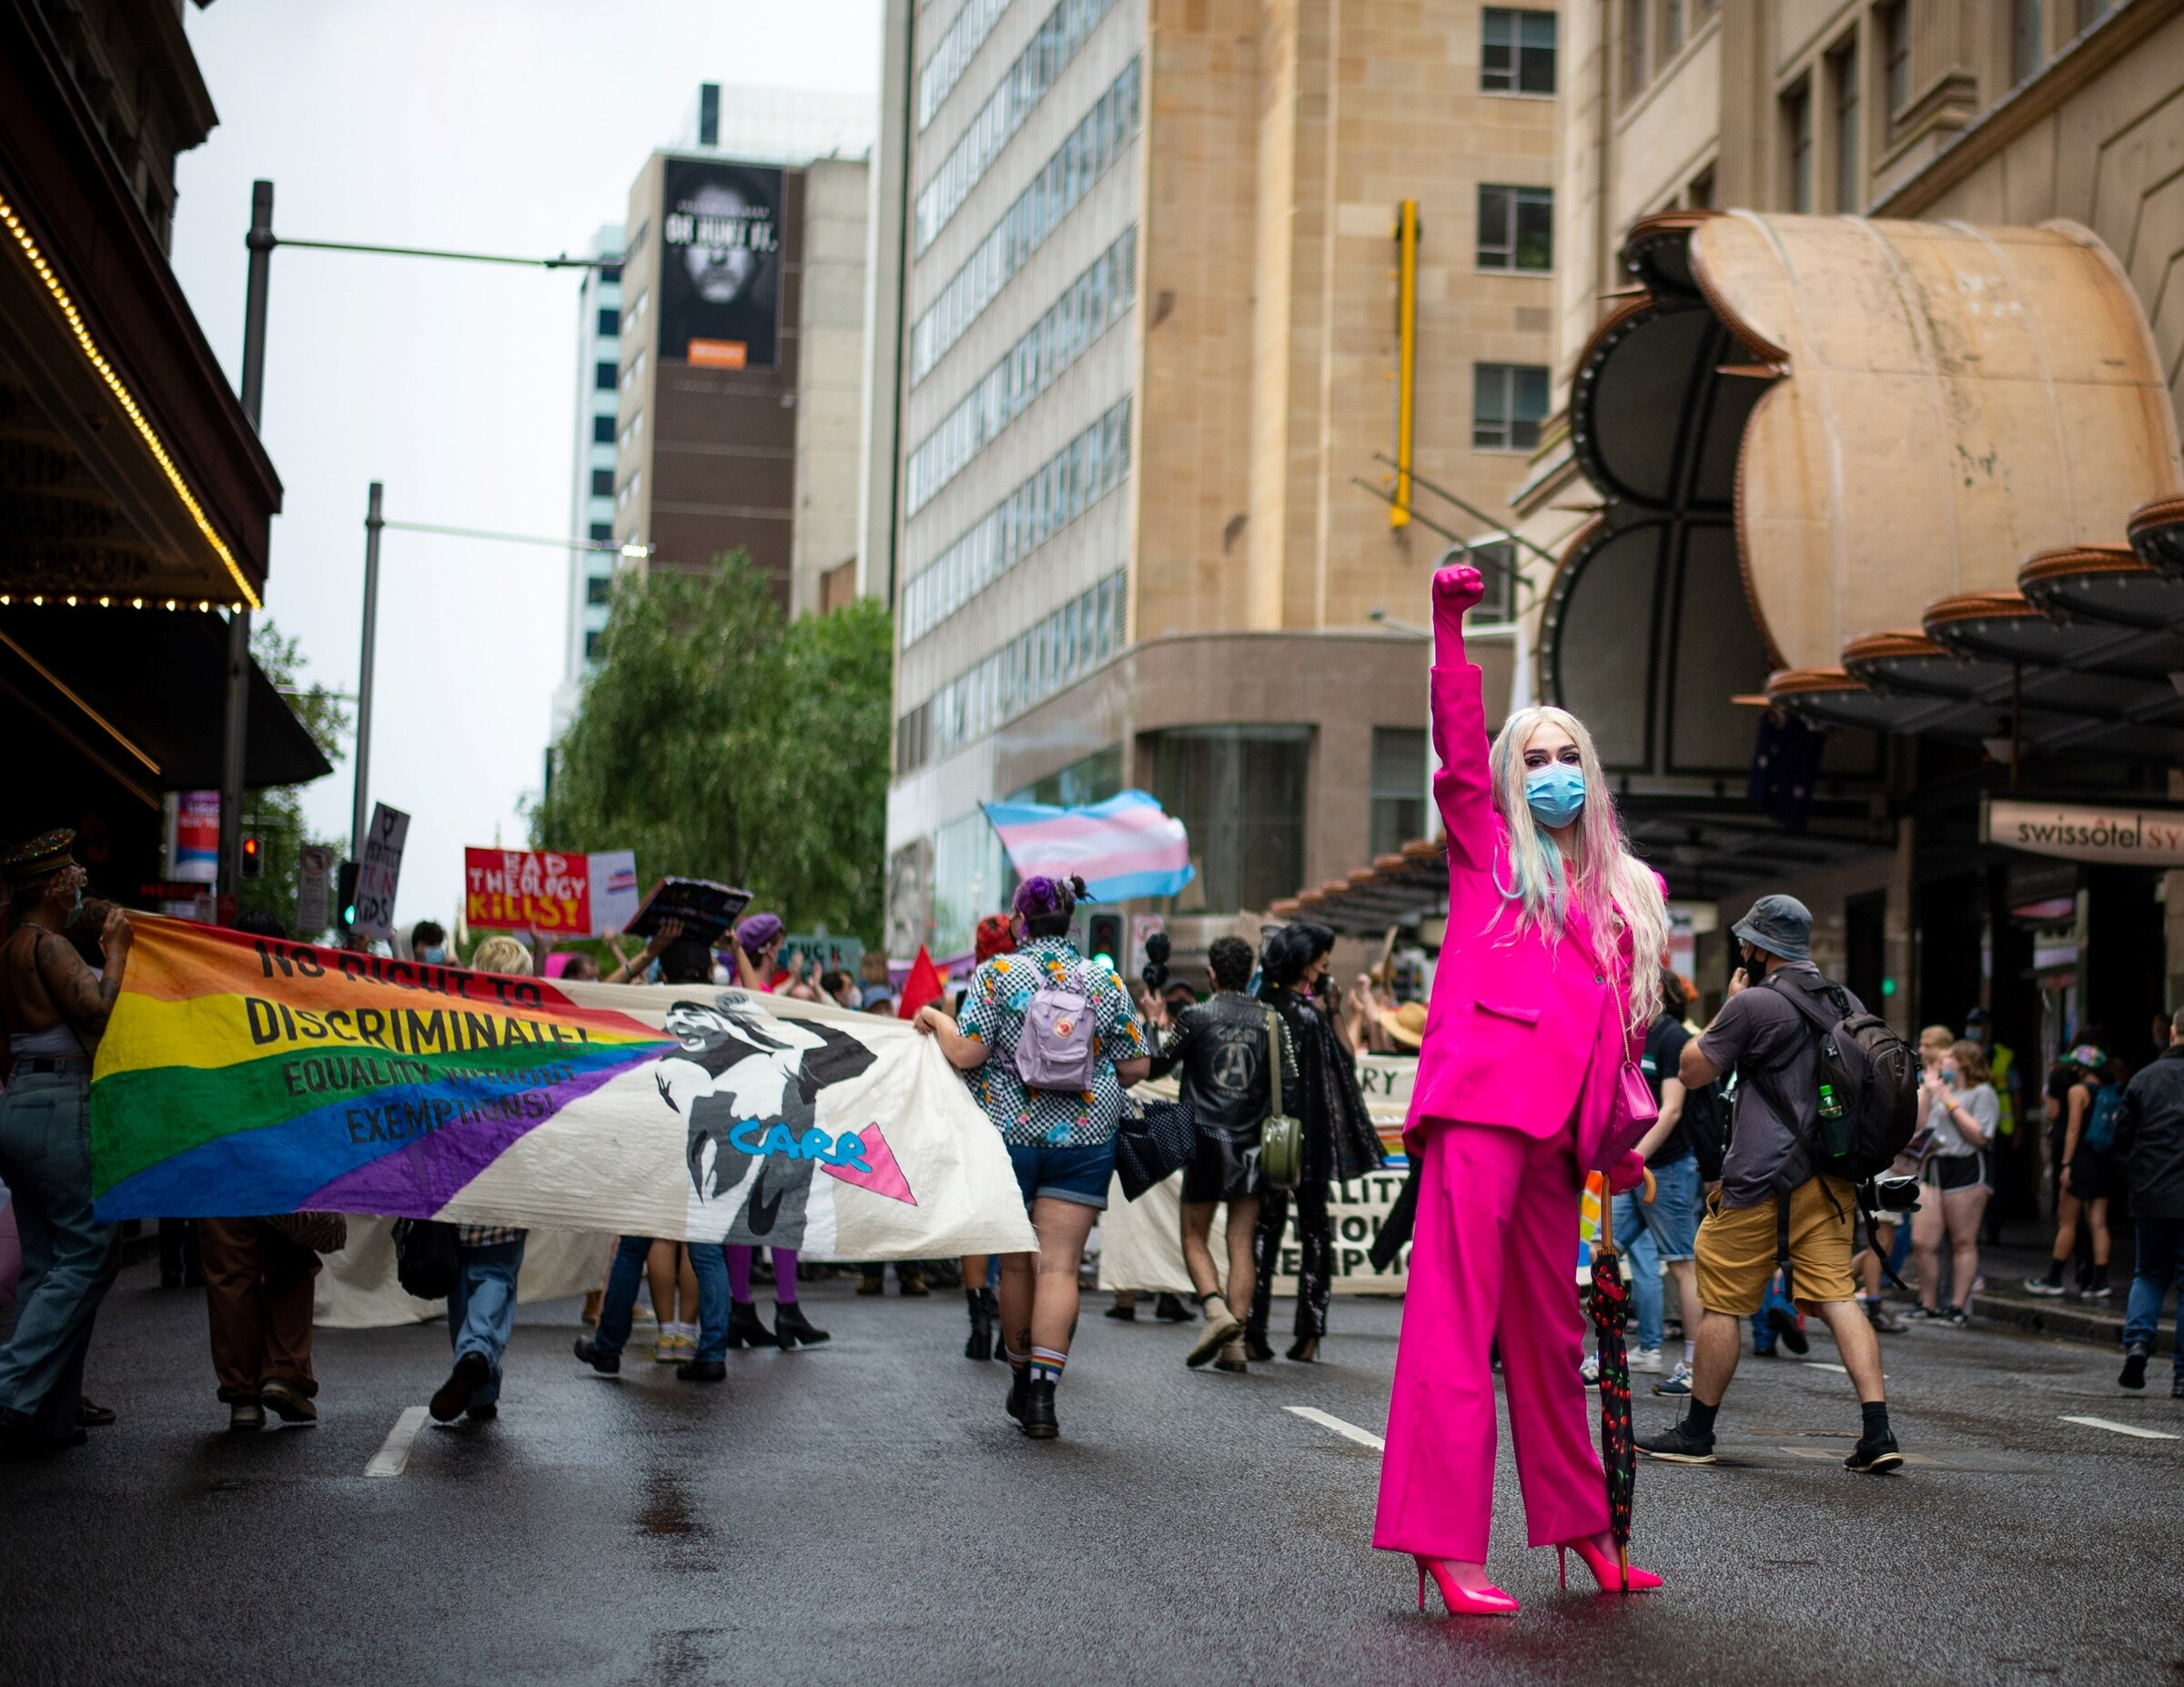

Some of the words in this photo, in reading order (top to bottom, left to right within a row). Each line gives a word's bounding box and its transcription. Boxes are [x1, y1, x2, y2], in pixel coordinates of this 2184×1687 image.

[469, 867, 586, 900] THEOLOGY
[504, 851, 568, 875] BAD
[255, 940, 325, 978] NO
[487, 976, 544, 1008] TO
[245, 996, 591, 1056] DISCRIMINATE!
[283, 1056, 430, 1097] EQUALITY
[346, 1093, 555, 1144] EXEMPTIONS!
